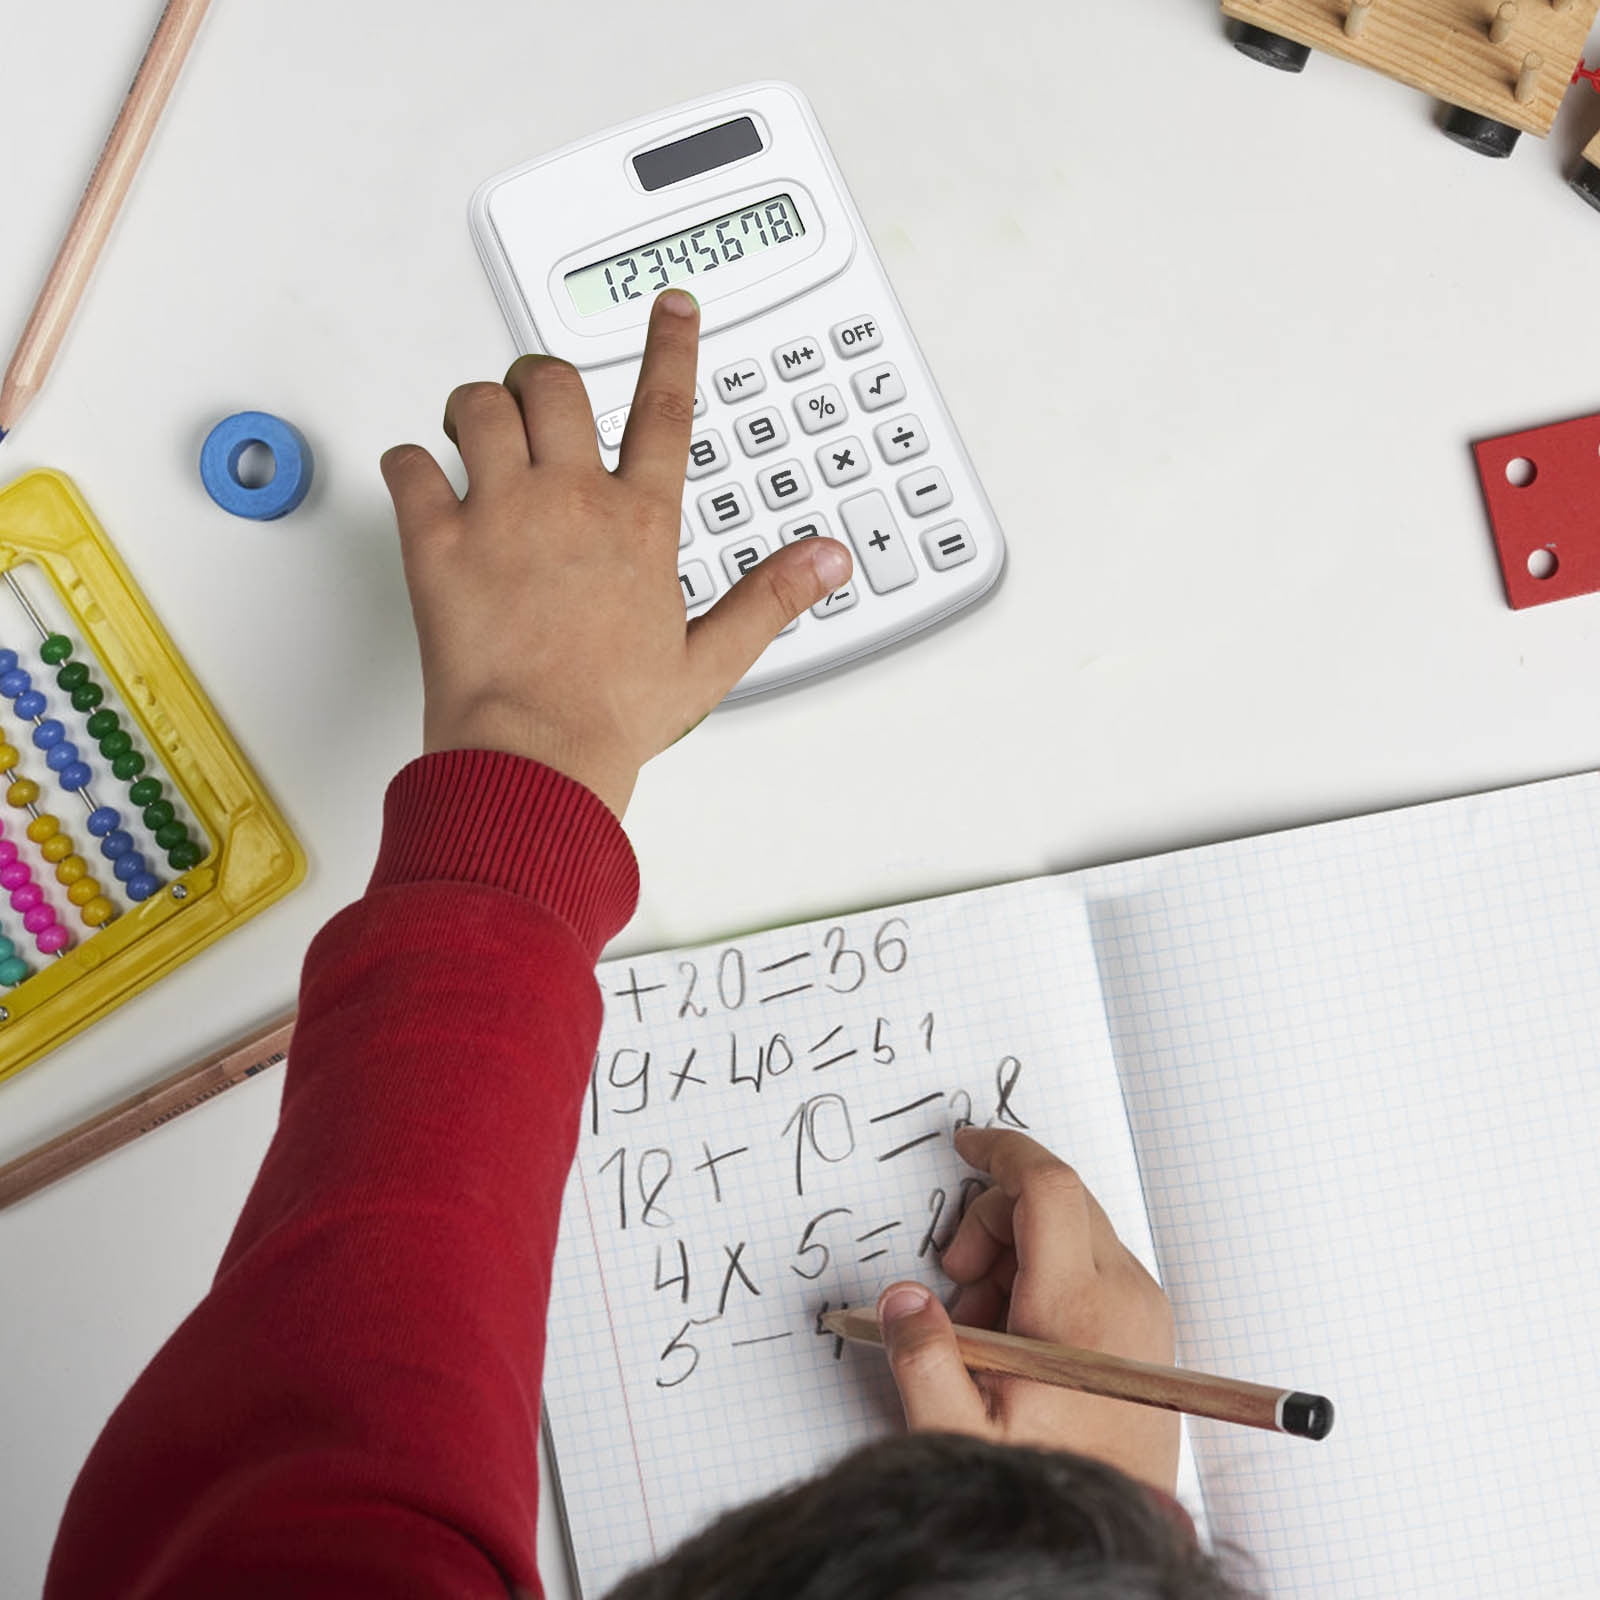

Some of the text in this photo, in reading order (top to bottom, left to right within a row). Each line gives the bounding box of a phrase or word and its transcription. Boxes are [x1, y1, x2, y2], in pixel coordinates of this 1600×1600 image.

[841, 322, 876, 345] OFF
[782, 346, 814, 369] M+
[808, 394, 836, 419] %
[749, 417, 776, 445] 9
[689, 440, 716, 466] 8
[770, 470, 798, 498] 6
[711, 492, 740, 521] 5
[868, 529, 890, 551] +
[938, 534, 966, 556] =
[733, 547, 759, 575] 2
[679, 574, 696, 597] 1
[653, 1239, 689, 1304] 4
[790, 1207, 853, 1280] 5
[656, 1313, 722, 1389] 5
